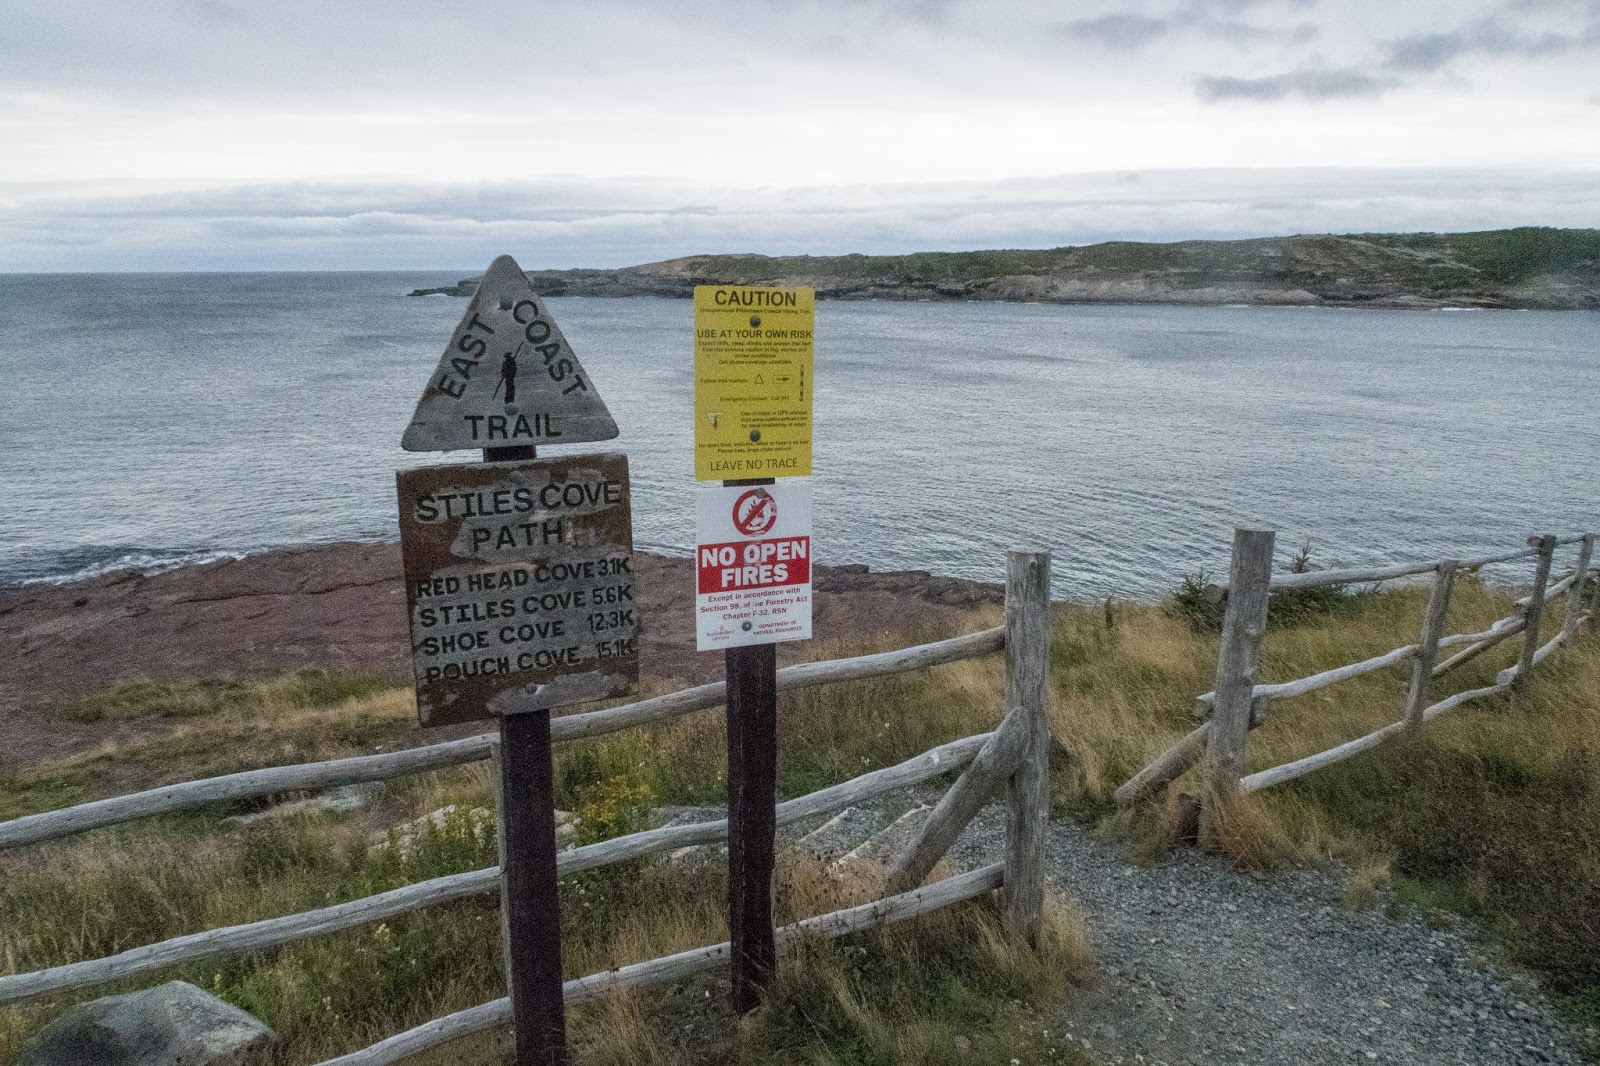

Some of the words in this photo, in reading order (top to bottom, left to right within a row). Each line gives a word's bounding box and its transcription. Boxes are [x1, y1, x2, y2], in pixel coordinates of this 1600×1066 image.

[714, 290, 797, 306] CAUTION
[513, 300, 587, 396] COAST
[696, 329, 718, 338] USE
[720, 330, 733, 338] AT
[736, 330, 762, 338] YOUR
[765, 330, 788, 338] OWN
[790, 330, 812, 339] RISK
[438, 313, 494, 400] EAST
[464, 414, 562, 440] TRAIL
[710, 460, 743, 471] LEAVE
[746, 460, 762, 470] NO
[766, 458, 798, 468] TRACE
[416, 488, 534, 522] STILES
[540, 480, 621, 509] COVE
[472, 520, 564, 552] PATH
[701, 546, 736, 568] NO
[743, 540, 807, 562] OPEN
[416, 576, 460, 599] RED
[468, 568, 529, 592] HEAD
[534, 560, 595, 584] COVE
[721, 563, 789, 588] FIRES
[420, 600, 516, 628] STILES
[522, 590, 586, 614] COVE
[700, 604, 728, 613] Section
[766, 598, 794, 606] Forestry
[708, 594, 733, 602] Except
[743, 590, 784, 598] accordance
[423, 630, 490, 656] SHOE
[500, 620, 566, 645] COVE
[426, 656, 510, 684] POUCH
[517, 646, 580, 672] COVE
